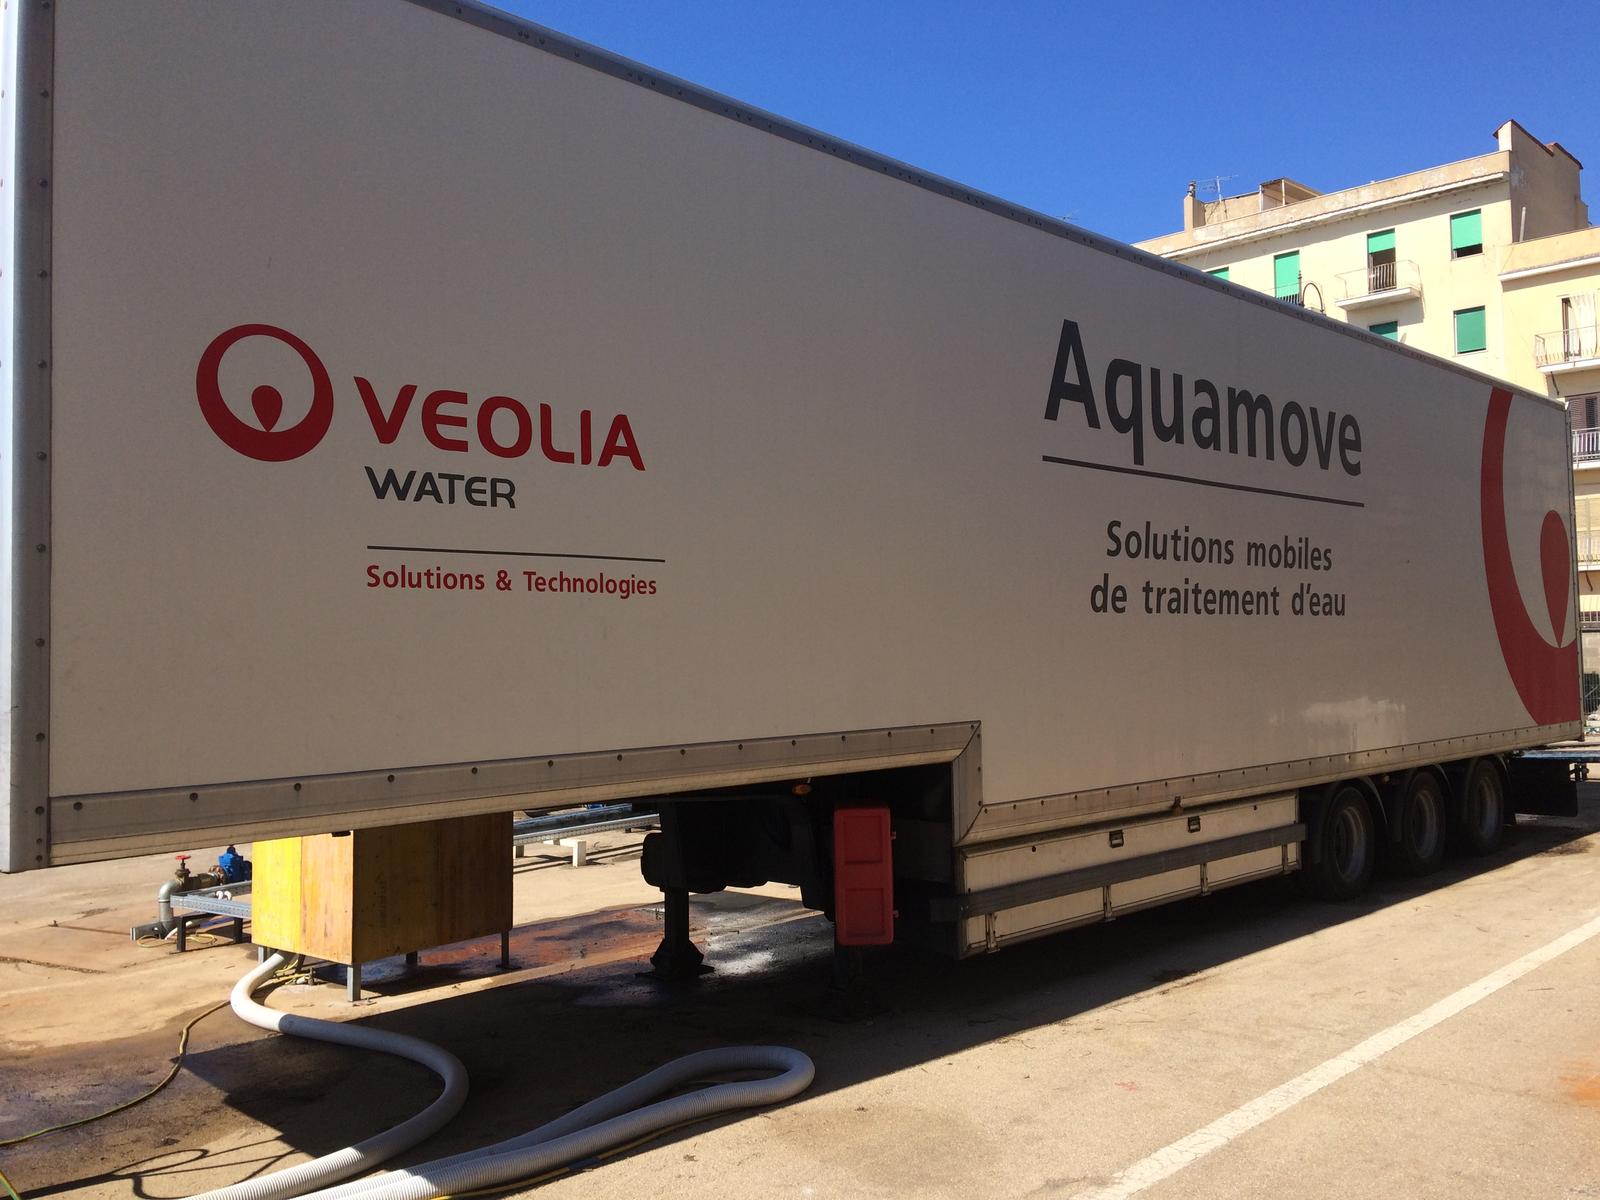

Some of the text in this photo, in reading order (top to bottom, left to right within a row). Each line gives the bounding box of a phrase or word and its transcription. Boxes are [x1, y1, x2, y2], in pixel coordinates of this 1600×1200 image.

[1044, 319, 1362, 477] Aquamove
[353, 375, 646, 471] VEOLIA
[364, 466, 516, 509] WATER
[1106, 520, 1332, 571] Solutions mobiles
[366, 564, 657, 599] Solutions & Technologies
[1090, 573, 1346, 617] de traitement d'eau
